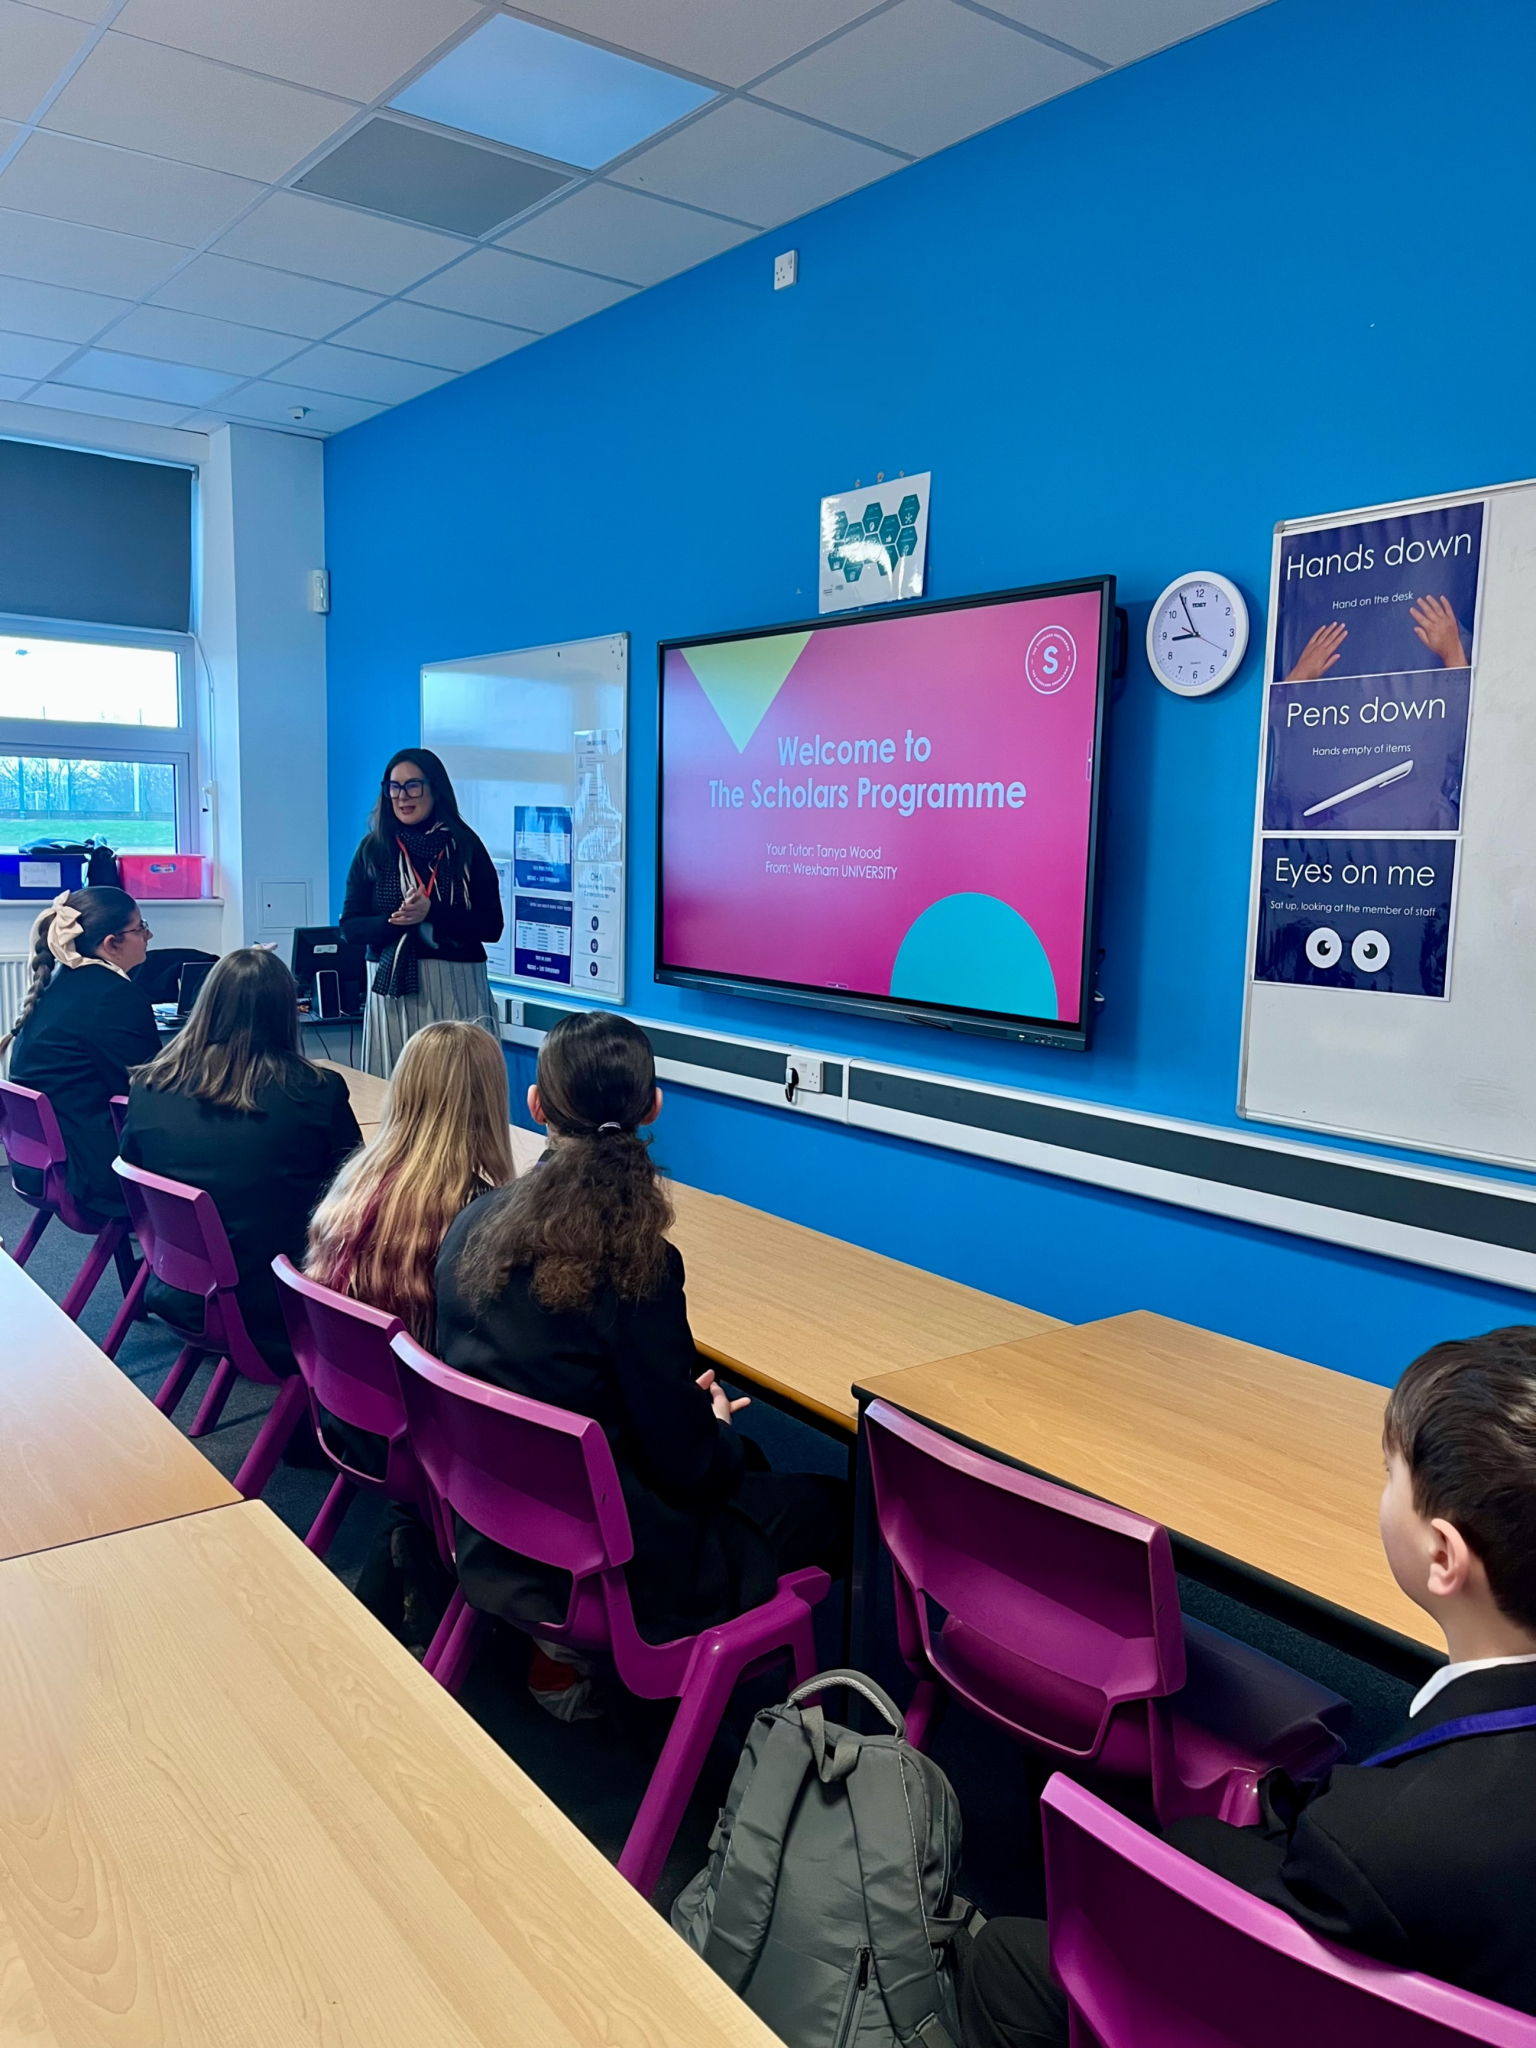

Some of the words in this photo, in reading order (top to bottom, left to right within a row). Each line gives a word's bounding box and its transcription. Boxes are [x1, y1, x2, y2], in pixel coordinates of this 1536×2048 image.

[1286, 543, 1375, 581] Hands
[1384, 533, 1472, 567] down
[1195, 588, 1205, 598] 12
[1332, 597, 1358, 610] Hand
[1359, 597, 1372, 607] on
[1374, 594, 1390, 605] the
[1391, 591, 1414, 603] desk
[1168, 610, 1178, 620] 10
[1224, 606, 1231, 616] 2
[1162, 631, 1168, 641] 9
[1229, 628, 1235, 638] 3
[1042, 645, 1059, 675] S
[1167, 651, 1173, 661] 8
[1221, 650, 1228, 659] 4
[1177, 665, 1183, 675] 7
[1192, 670, 1198, 680] 6
[1209, 664, 1215, 674] 5
[1287, 702, 1350, 728] Pens
[1359, 696, 1446, 724] down
[777, 734, 897, 766] Welcome
[904, 729, 932, 762] to
[1312, 746, 1340, 756] Hands
[1342, 746, 1372, 756] empty
[1374, 744, 1384, 754] of
[1385, 744, 1412, 753] items
[709, 779, 745, 809] The
[750, 777, 849, 809] Scholars
[857, 777, 1027, 817] Programme
[766, 842, 787, 856] Your
[788, 843, 815, 857] Tutor:
[816, 844, 847, 861] Tanya
[849, 845, 882, 860] Wood
[765, 861, 791, 874] From:
[793, 862, 839, 877] Wrexham
[841, 865, 898, 880] UNIVERSITY
[1275, 857, 1333, 888] Eyes
[1341, 864, 1378, 885] on
[1387, 865, 1435, 887] me
[1270, 900, 1284, 910] Sat
[1286, 903, 1299, 912] up,
[1301, 902, 1332, 913] looking
[1334, 903, 1344, 912] at
[1345, 904, 1360, 913] the
[1362, 906, 1401, 915] member
[1403, 907, 1414, 916] of
[1415, 907, 1436, 917] staff
